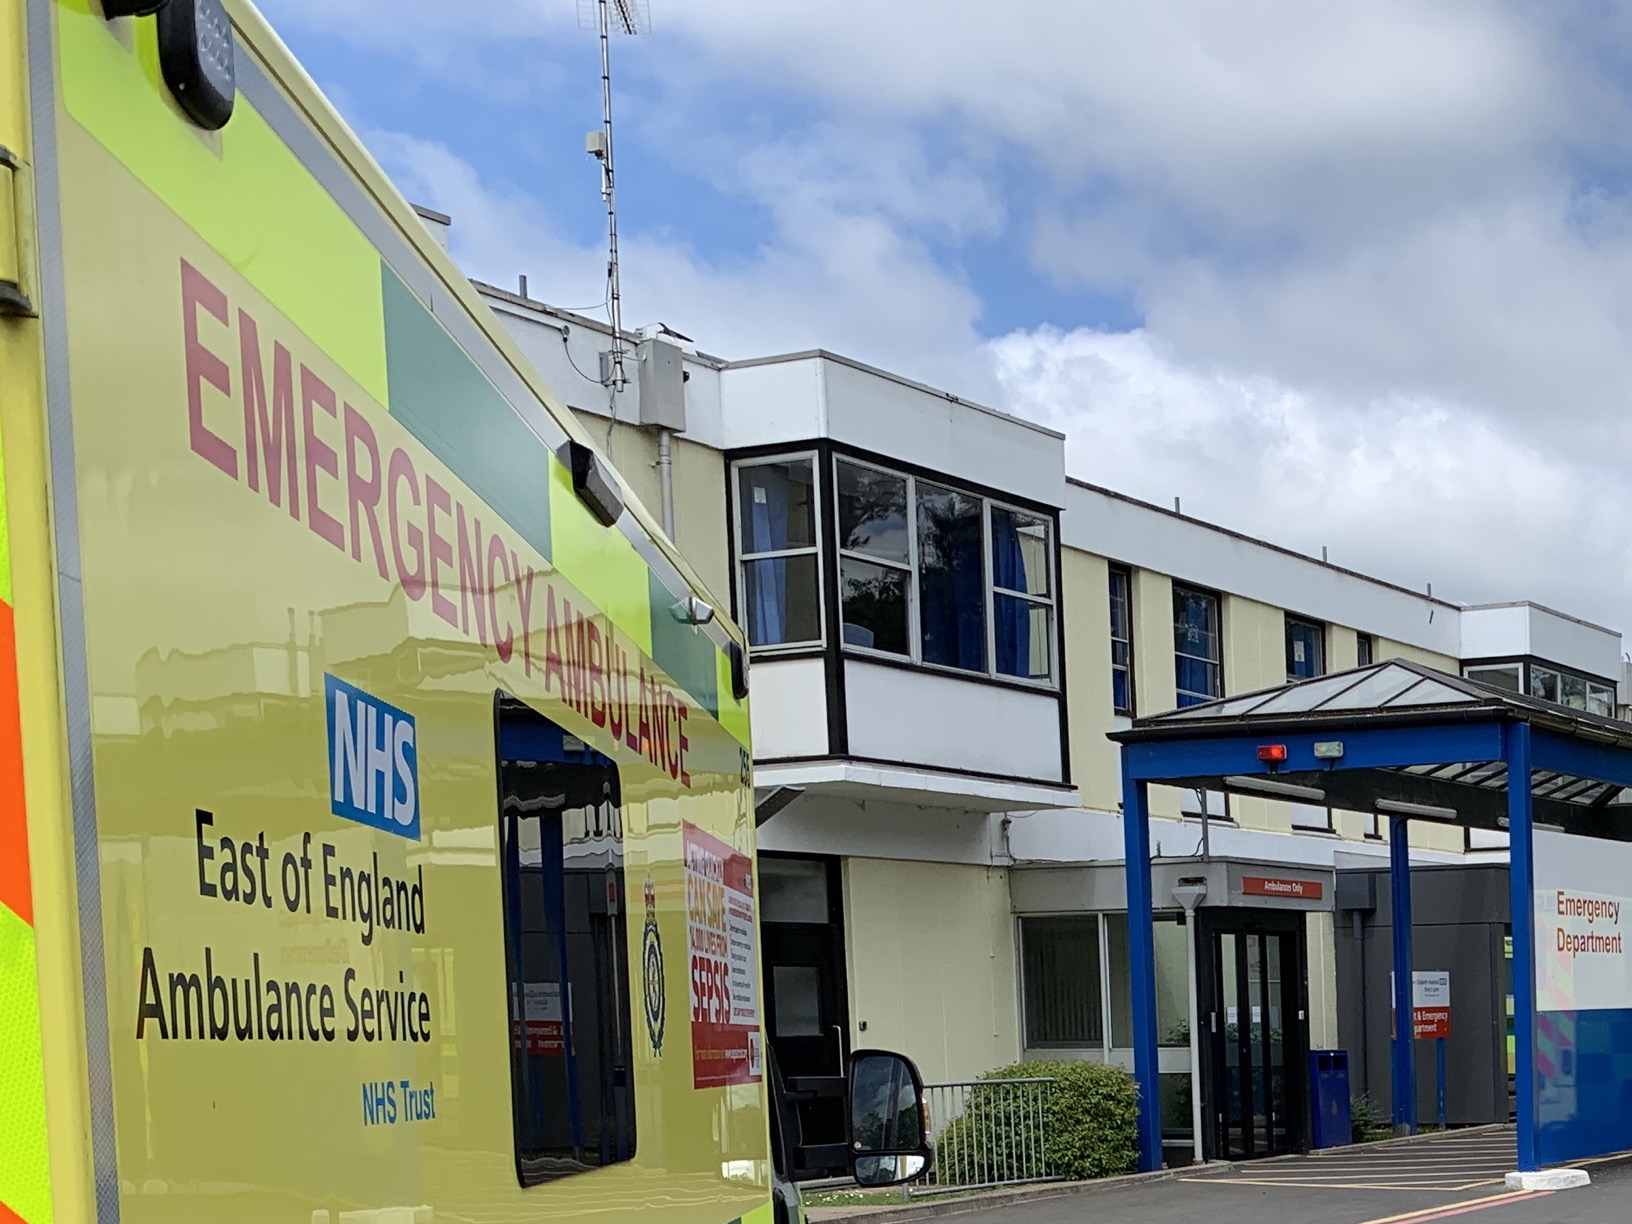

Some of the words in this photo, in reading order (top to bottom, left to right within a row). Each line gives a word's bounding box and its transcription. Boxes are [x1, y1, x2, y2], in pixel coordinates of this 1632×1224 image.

[181, 257, 536, 679] EMERGENCY
[544, 584, 693, 789] AMBULANCE
[332, 688, 417, 830] NHS
[195, 809, 278, 908] East
[282, 829, 312, 915] of
[324, 844, 427, 945] England
[687, 873, 705, 926] CAN
[706, 879, 727, 933] SAVE
[1264, 881, 1292, 892] Ambulances
[1292, 883, 1303, 895] Only
[1557, 890, 1620, 924] Emergency
[1557, 927, 1622, 958] Department
[137, 946, 336, 1042] Ambulance
[346, 969, 432, 1043] Service
[691, 954, 731, 1024] SEPSIS
[1414, 1024, 1437, 1035] partment
[1422, 1011, 1448, 1022] Emergency
[362, 1083, 397, 1128] NHS
[400, 1080, 436, 1125] Trust
